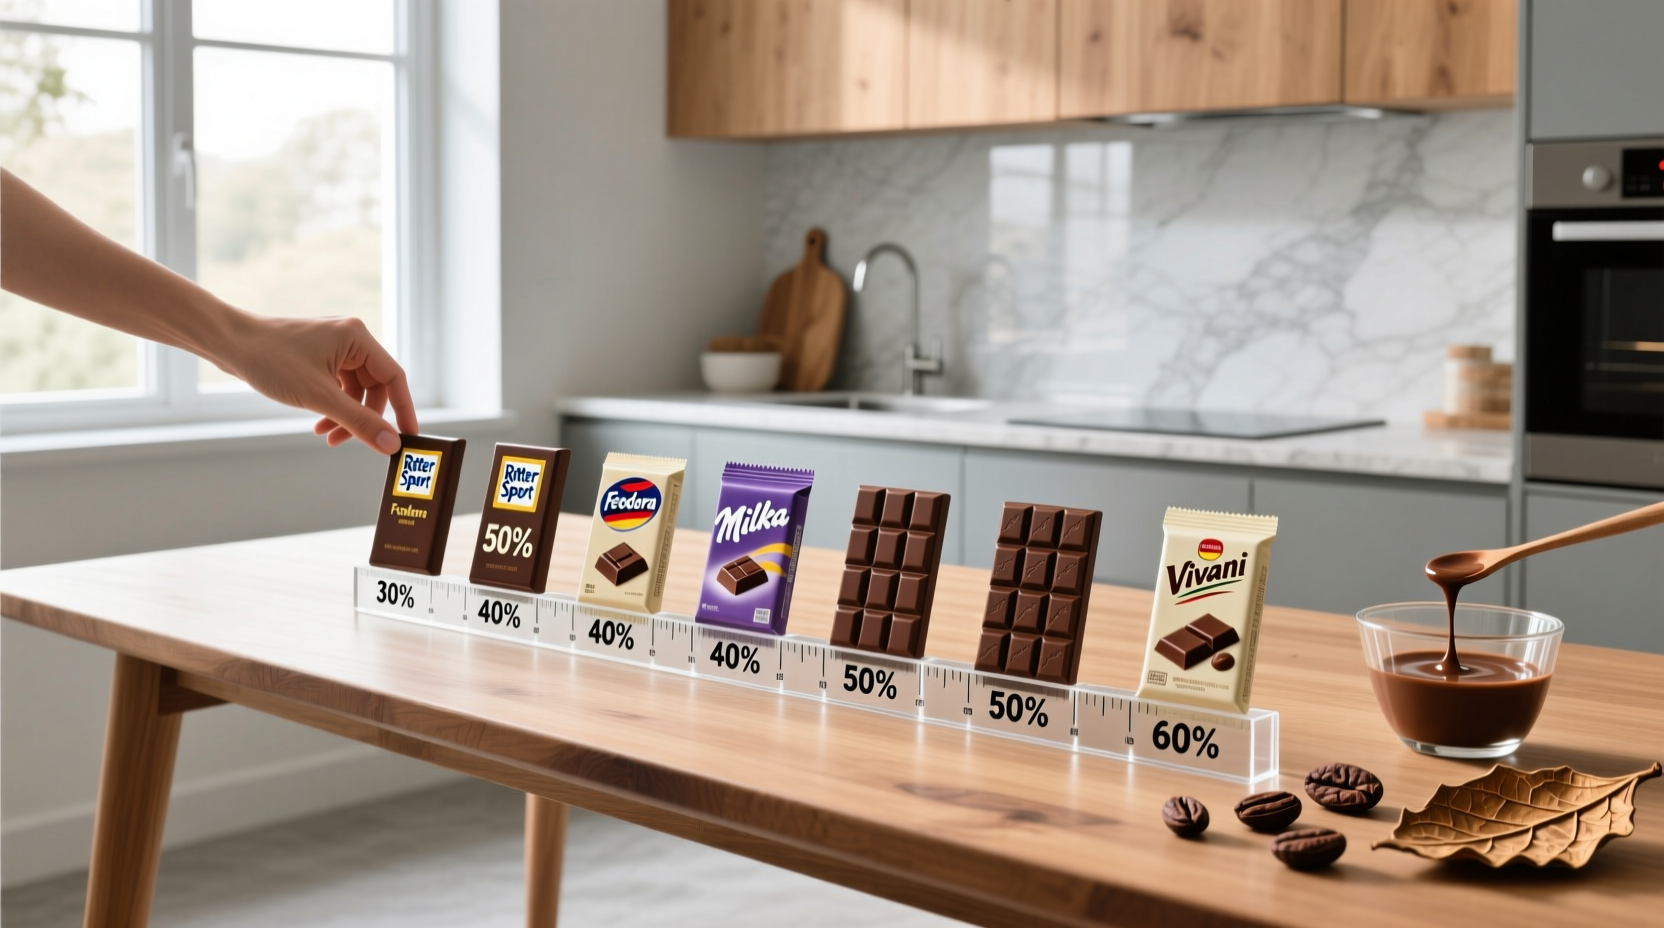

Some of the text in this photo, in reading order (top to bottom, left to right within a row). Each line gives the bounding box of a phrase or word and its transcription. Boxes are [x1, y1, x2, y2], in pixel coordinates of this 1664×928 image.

[404, 454, 436, 472] Ritter
[505, 464, 540, 483] Ritter
[501, 480, 534, 502] Sport
[603, 491, 657, 511] Feodora
[714, 500, 790, 543] Milka
[482, 523, 533, 558] 50%
[1166, 551, 1249, 595] Vivani
[376, 580, 415, 608] 30%
[477, 599, 521, 629] 40%
[588, 618, 635, 650] 40%
[709, 641, 761, 674] 40%
[843, 664, 897, 700] 50%
[988, 690, 1049, 728] 50%
[1152, 720, 1220, 760] 60%
